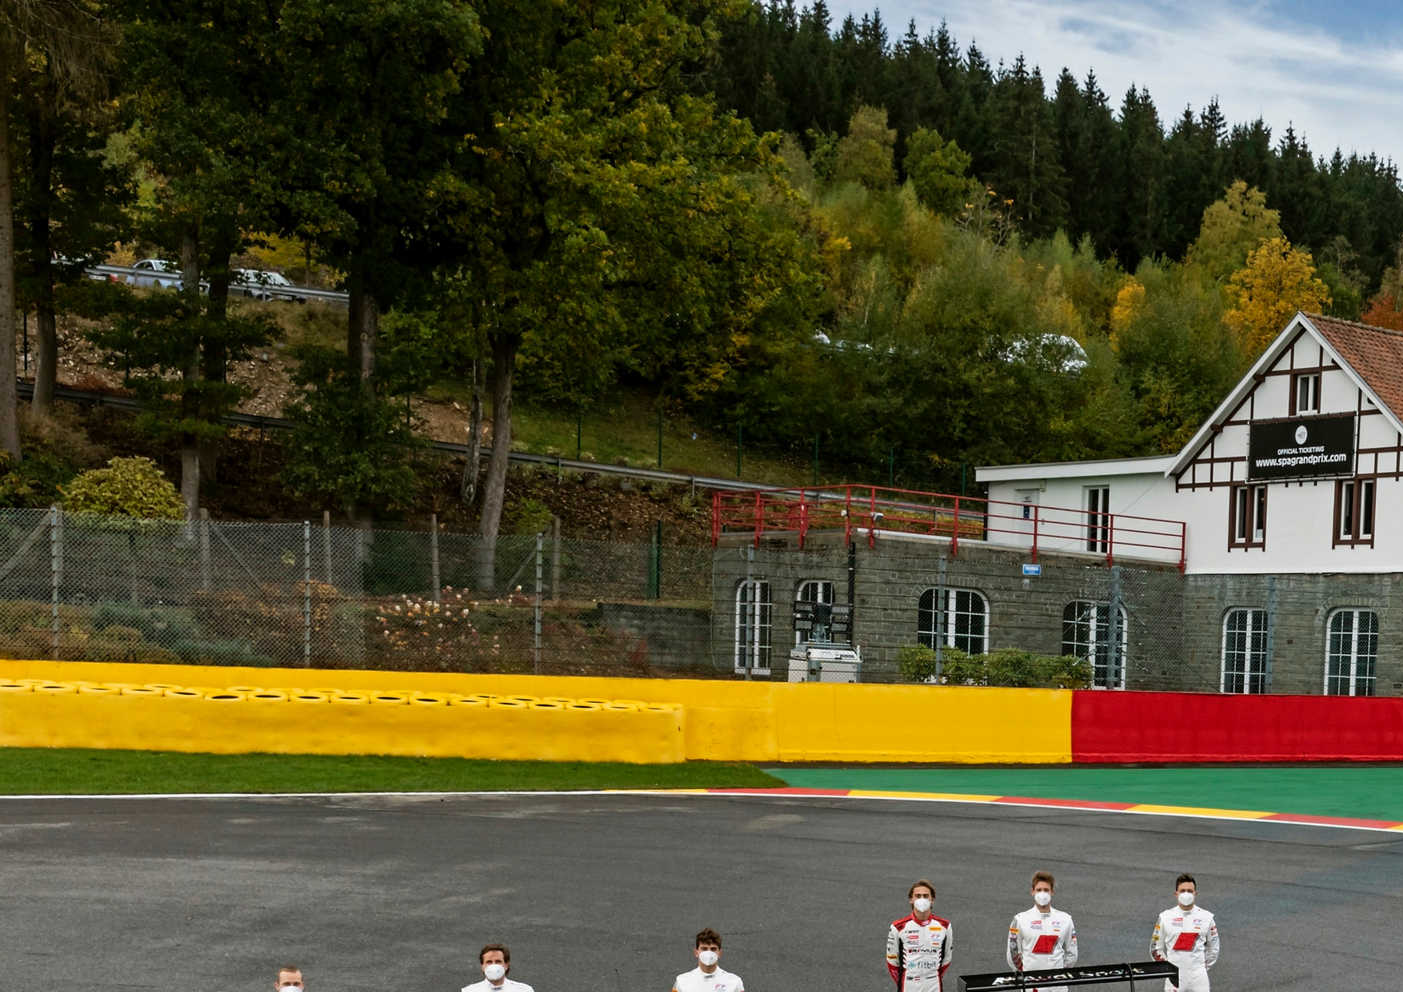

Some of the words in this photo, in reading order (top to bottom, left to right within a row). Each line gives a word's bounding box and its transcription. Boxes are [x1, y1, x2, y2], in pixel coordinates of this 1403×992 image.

[1277, 448, 1298, 456] OFFICIAL
[1299, 445, 1324, 454] TICKETING
[1256, 453, 1346, 468] www.spagrandprix.com
